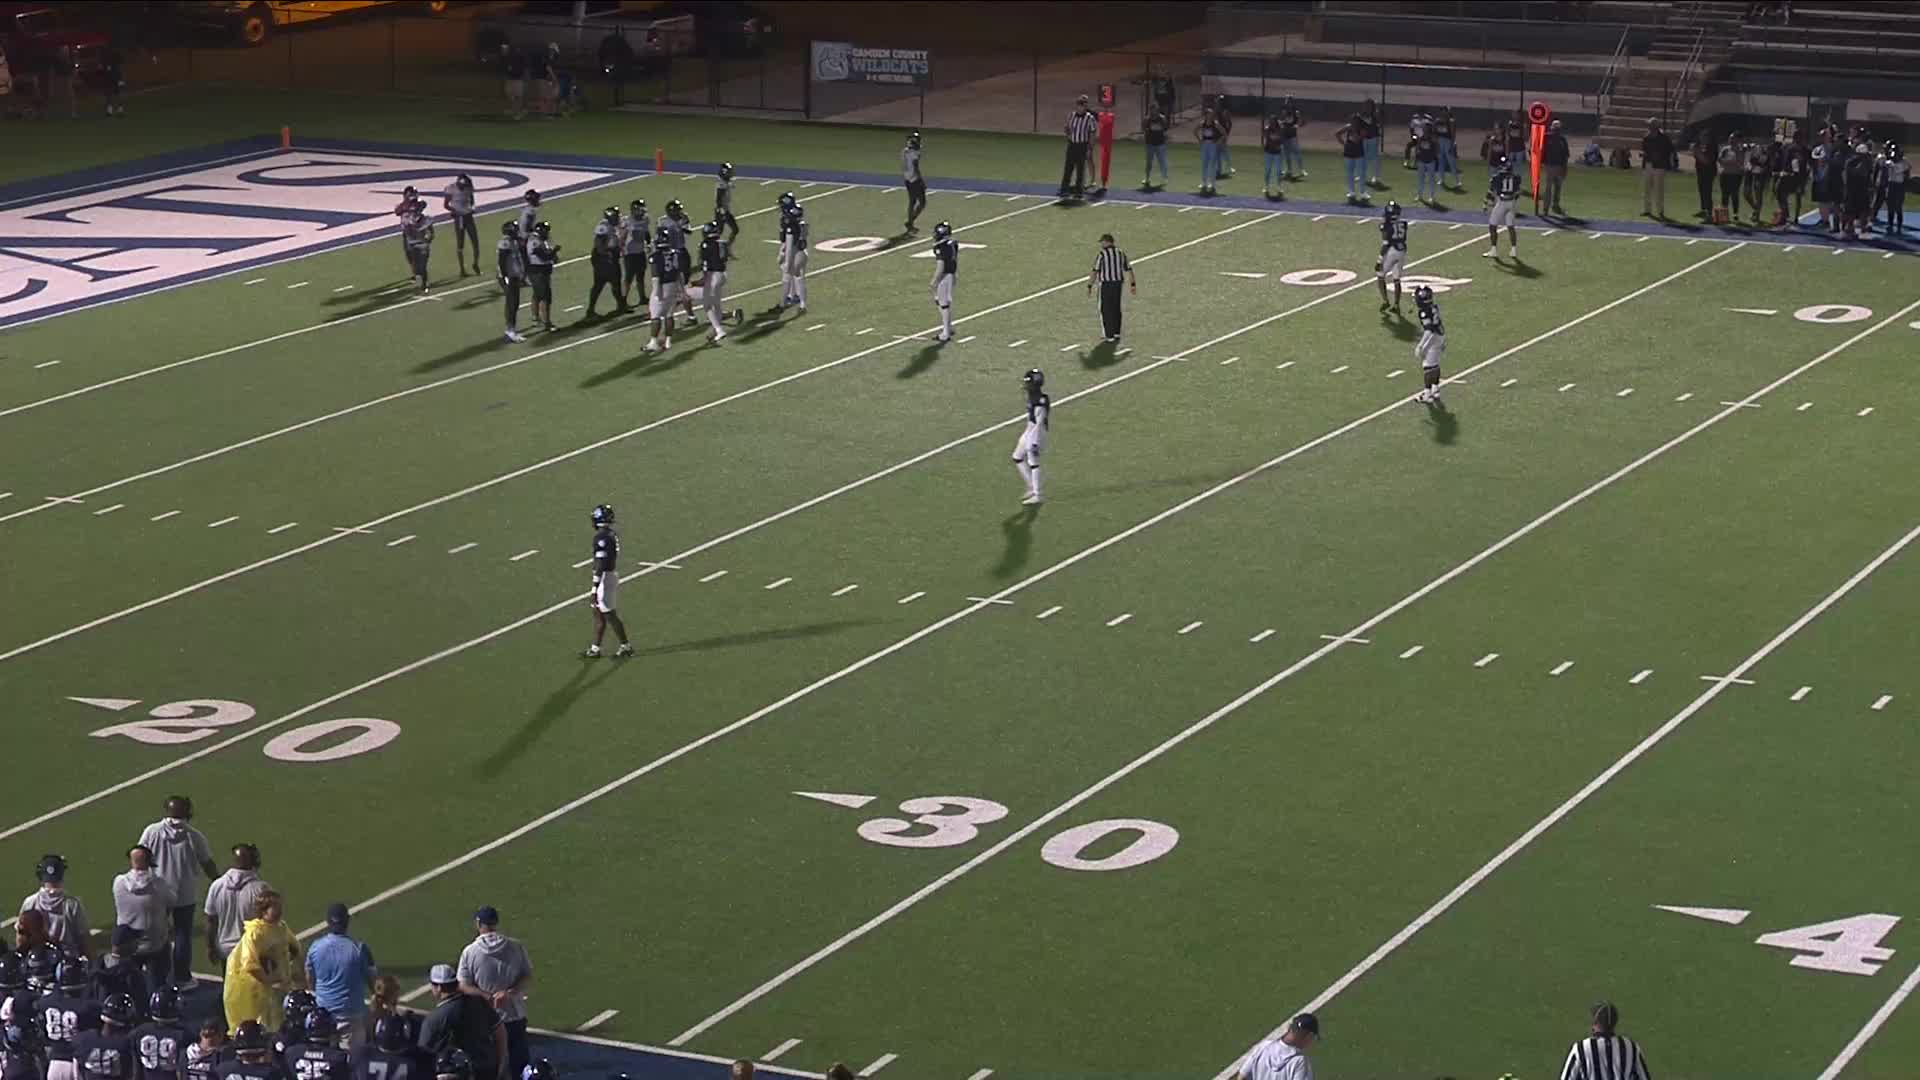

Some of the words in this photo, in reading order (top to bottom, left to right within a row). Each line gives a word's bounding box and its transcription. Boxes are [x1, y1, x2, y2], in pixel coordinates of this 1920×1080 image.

[852, 58, 928, 73] WILDCATS
[1391, 222, 1406, 240] 15
[88, 699, 402, 762] 20
[856, 795, 1180, 871] 30
